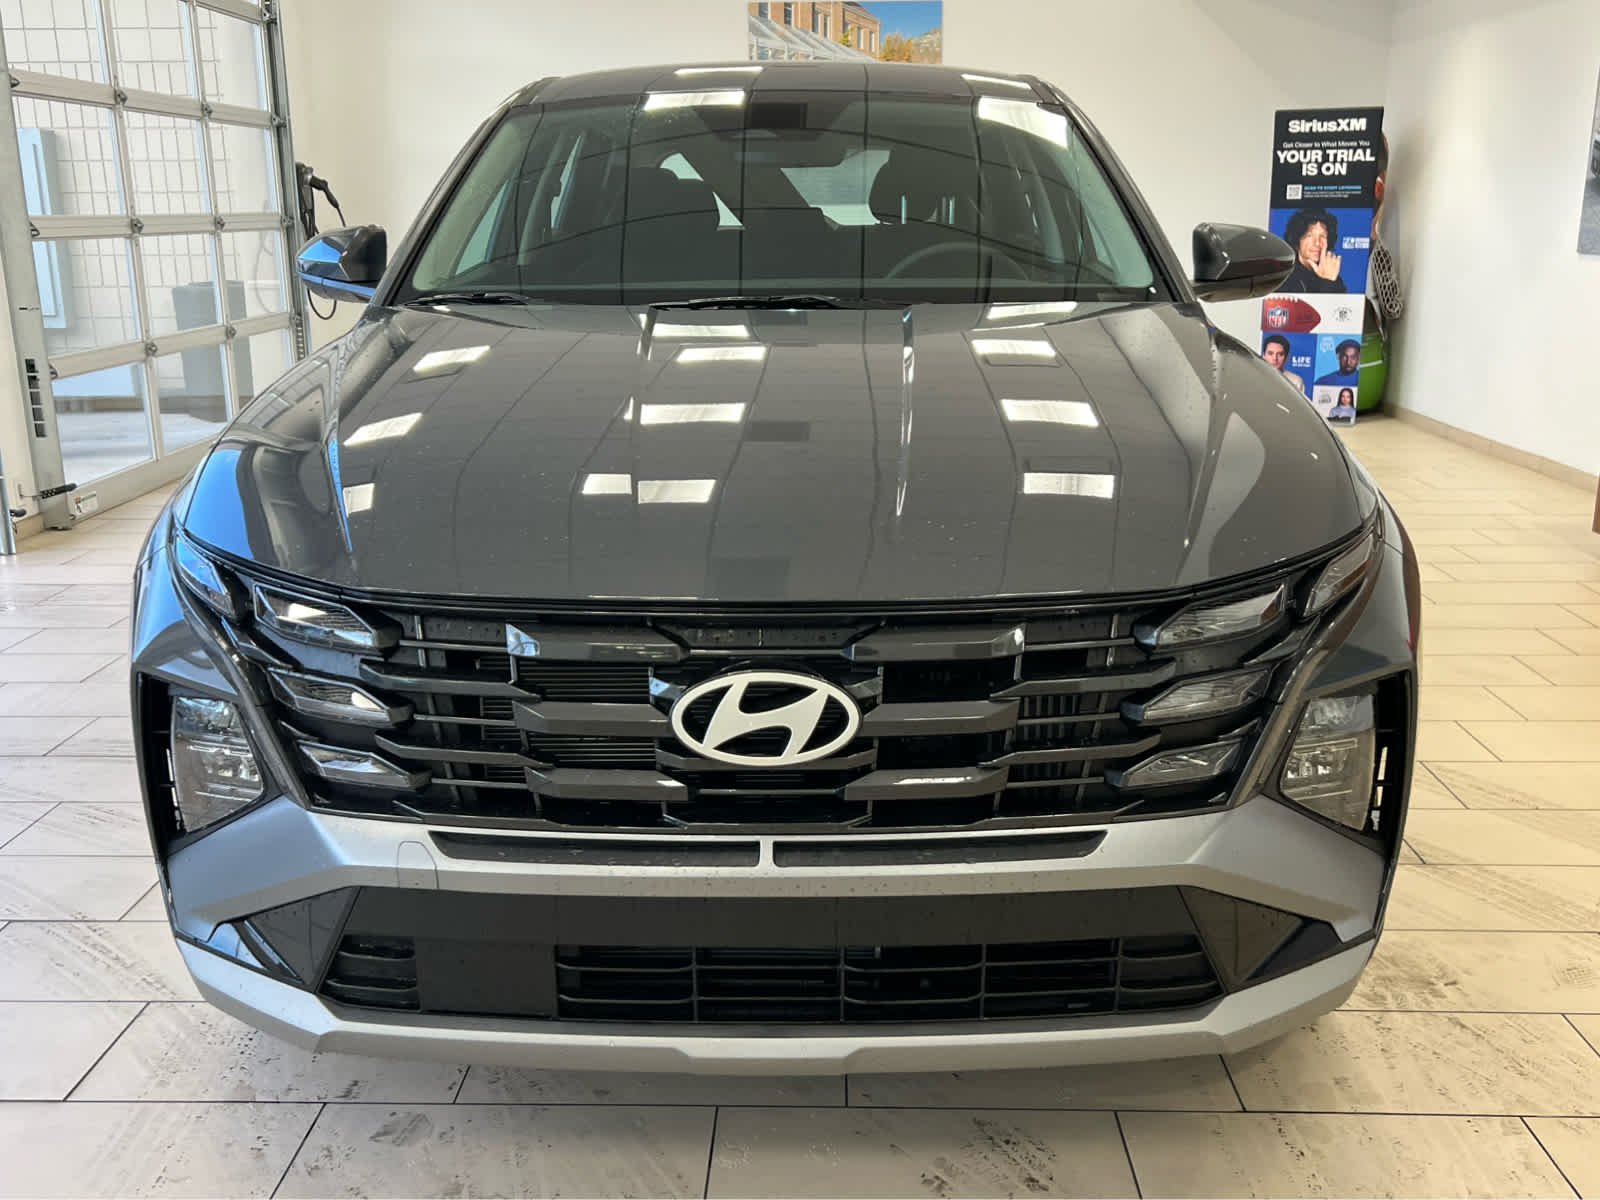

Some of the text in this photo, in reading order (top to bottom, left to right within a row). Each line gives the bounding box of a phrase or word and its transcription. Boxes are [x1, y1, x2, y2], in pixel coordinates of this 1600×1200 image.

[1288, 118, 1367, 133] SiriusXM
[1277, 148, 1376, 164] YOUR TRIAL
[1301, 162, 1347, 176] IS ON
